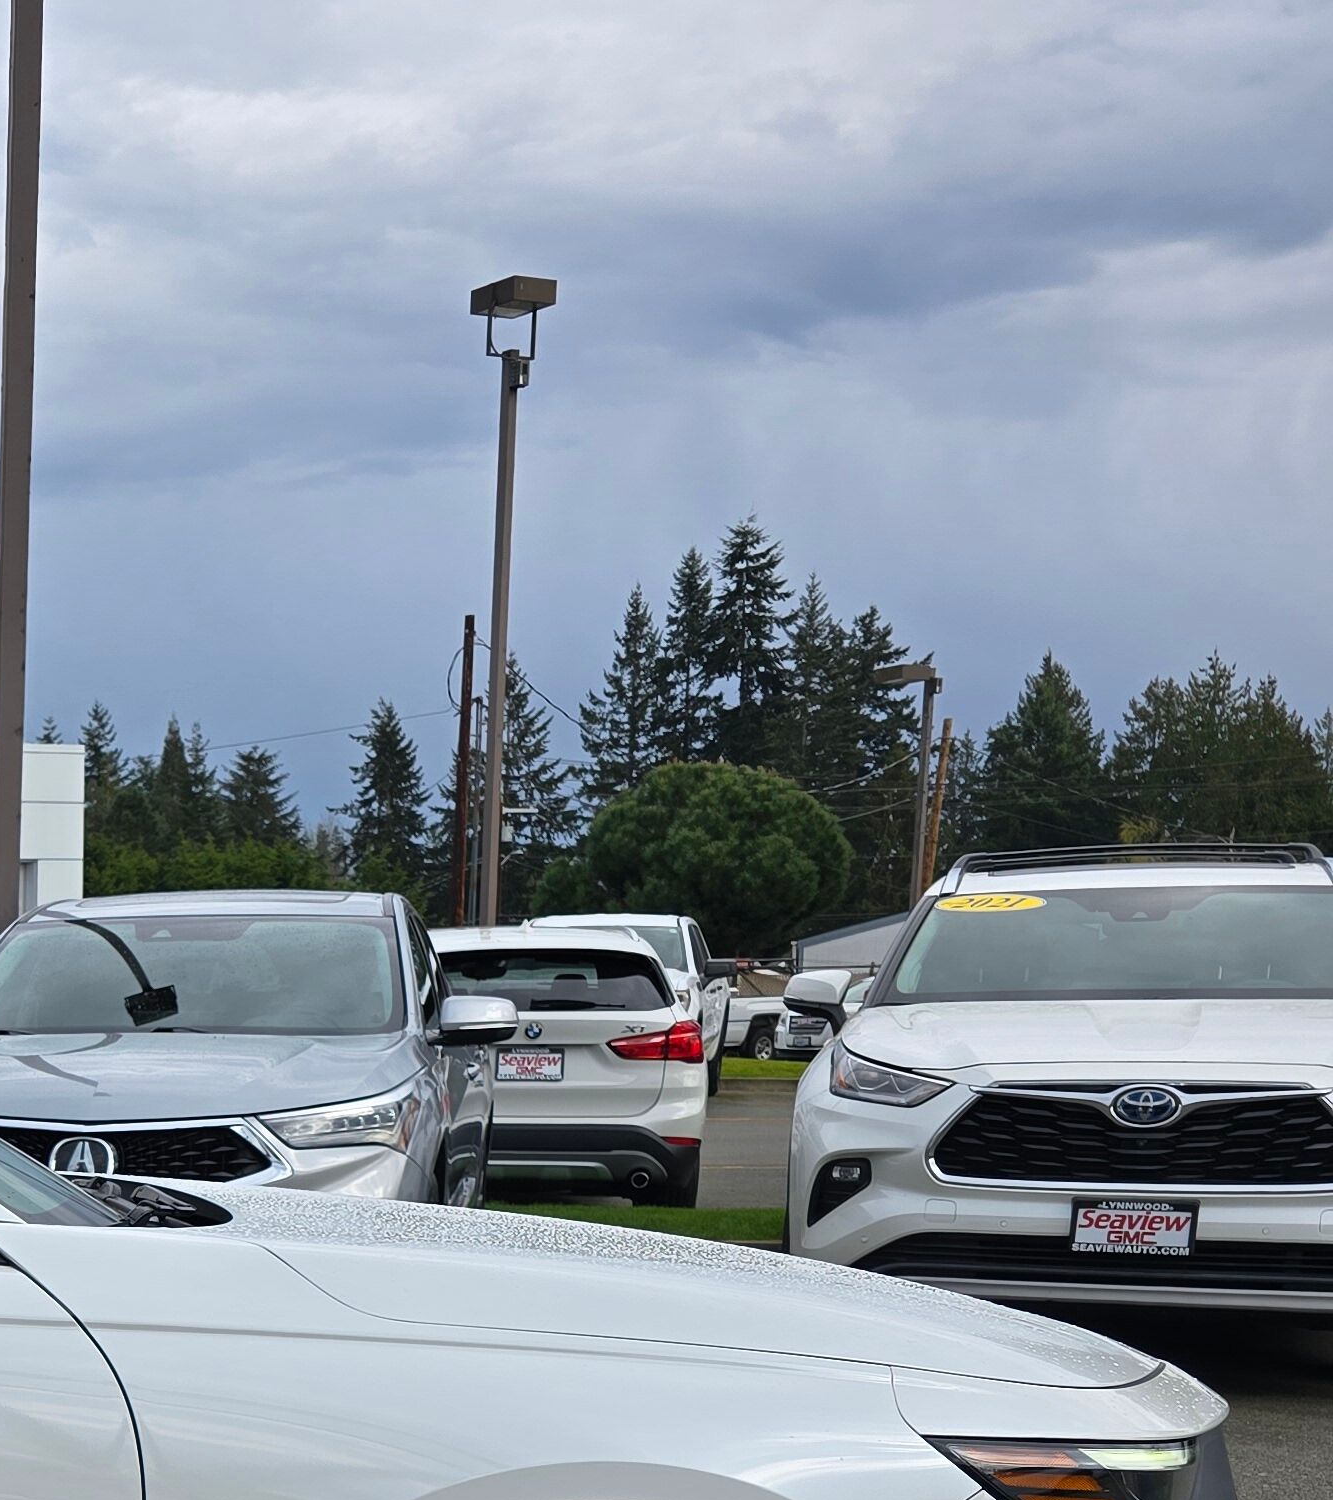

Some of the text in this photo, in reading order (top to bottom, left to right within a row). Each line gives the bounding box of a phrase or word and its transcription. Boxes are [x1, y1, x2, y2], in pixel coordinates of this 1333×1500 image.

[950, 897, 1027, 909] 2021
[621, 1024, 645, 1034] X1
[499, 1053, 562, 1067] Seaview
[1102, 1201, 1170, 1211] LYNNWOOD
[1078, 1210, 1192, 1232] Seaview
[1106, 1231, 1158, 1245] GMC
[1071, 1243, 1190, 1256] SEAVIEWAUTO.COM
